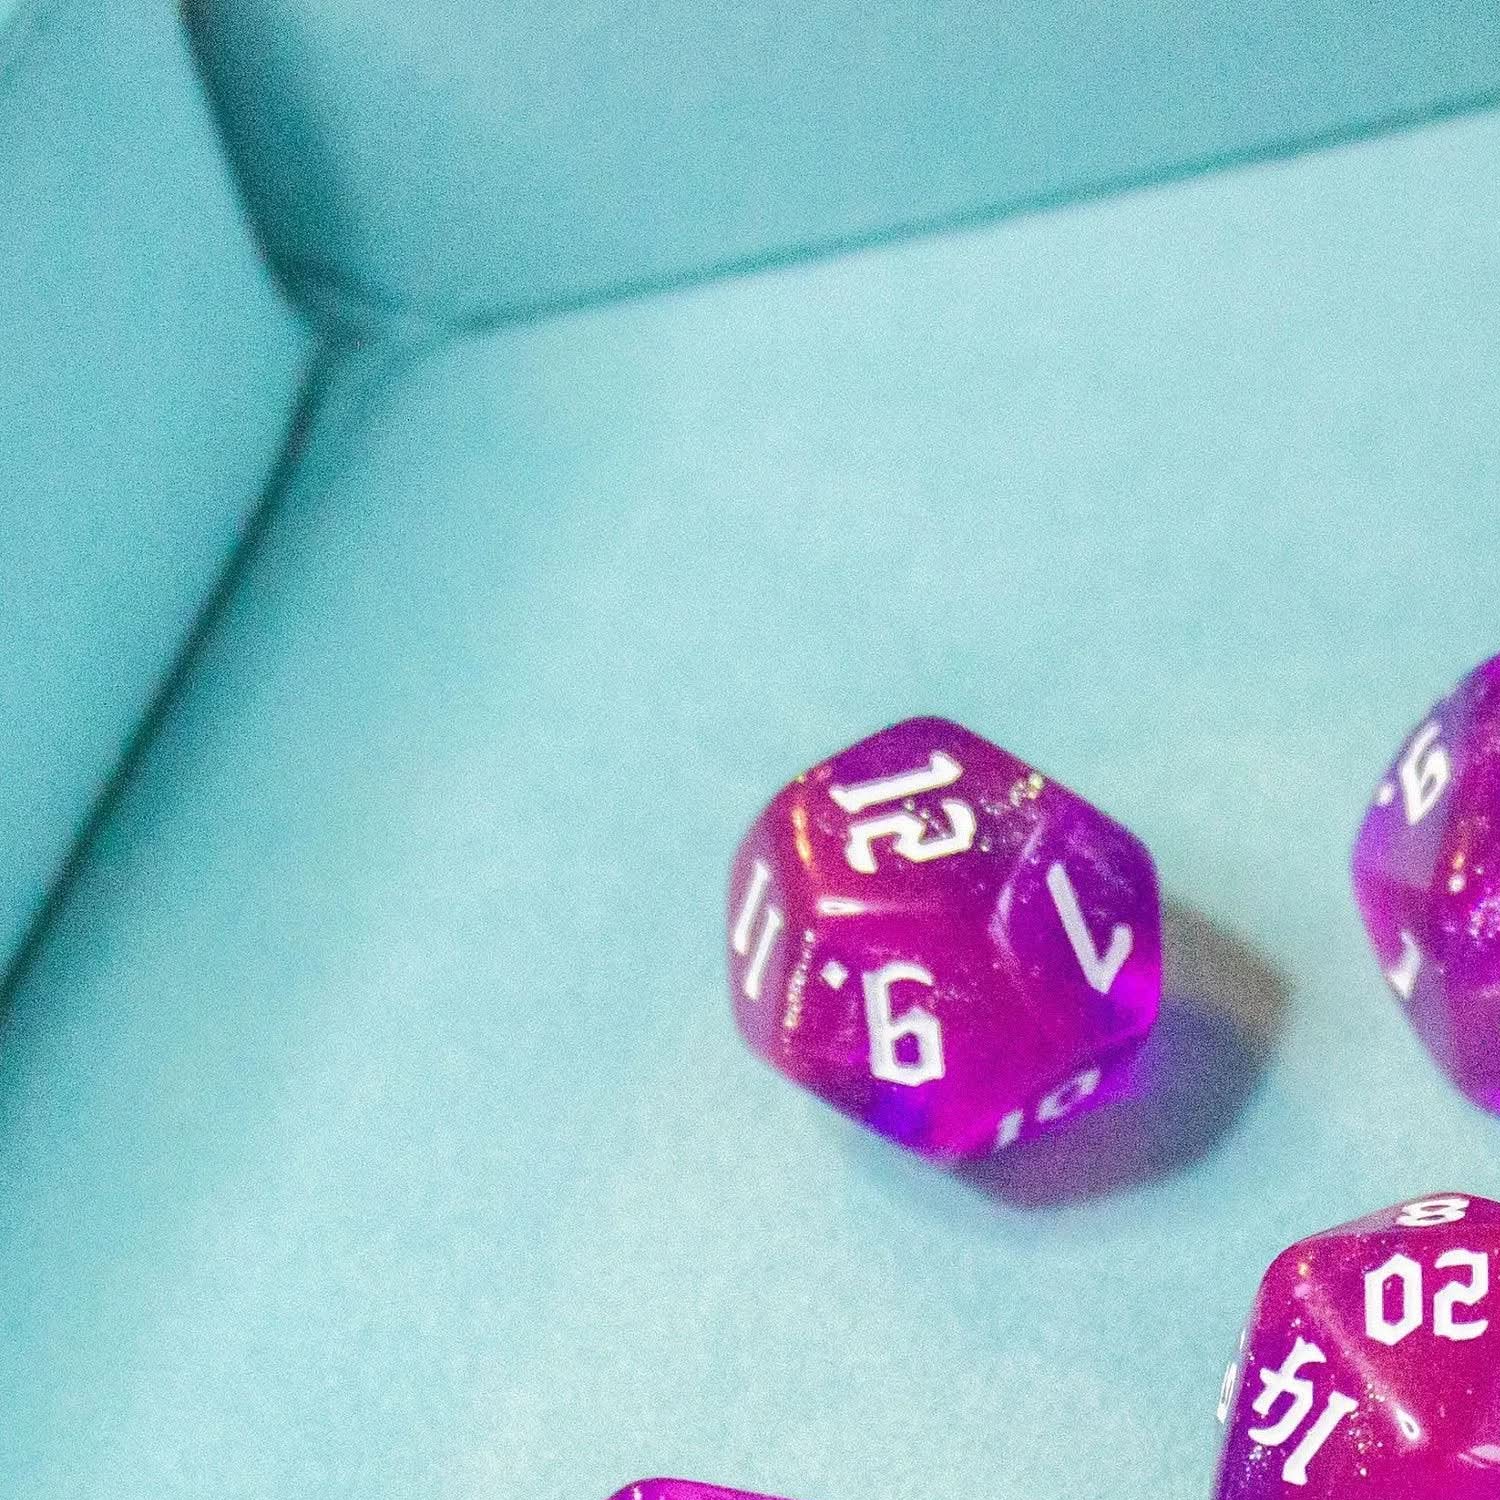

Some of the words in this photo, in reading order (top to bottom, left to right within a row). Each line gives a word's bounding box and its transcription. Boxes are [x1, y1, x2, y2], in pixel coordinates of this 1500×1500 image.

[829, 751, 977, 873] 12
[1364, 1248, 1489, 1346] 20
[1248, 1336, 1358, 1485] 14
